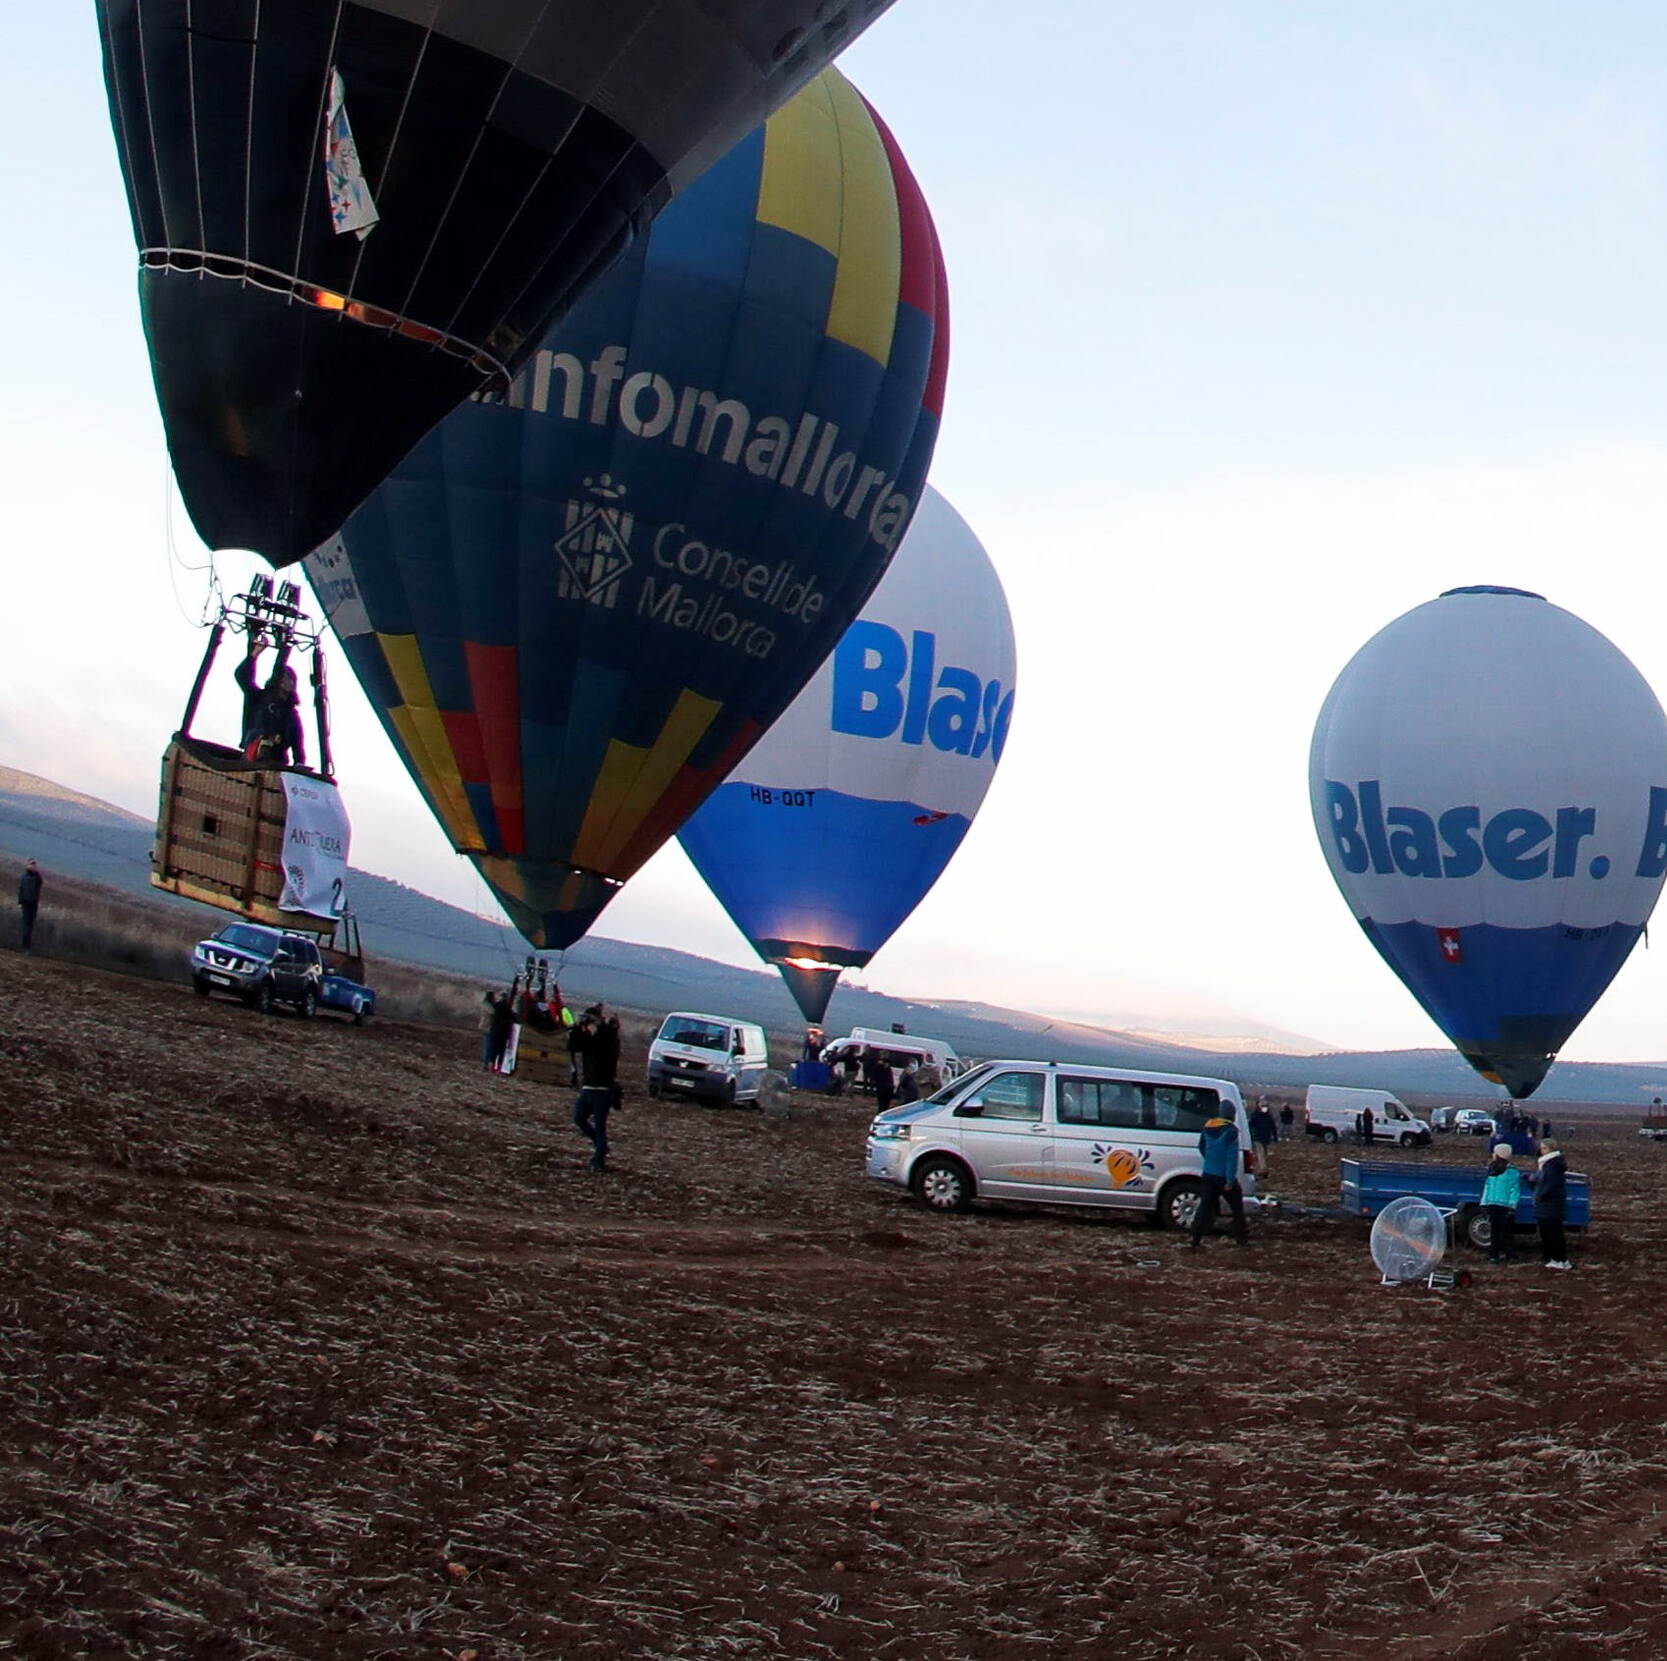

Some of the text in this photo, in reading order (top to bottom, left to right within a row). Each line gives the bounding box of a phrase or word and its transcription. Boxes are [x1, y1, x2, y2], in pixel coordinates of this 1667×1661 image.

[636, 575, 777, 659] Mallorca
[653, 522, 825, 624] Consell de
[1325, 779, 1611, 881] Blaser.
